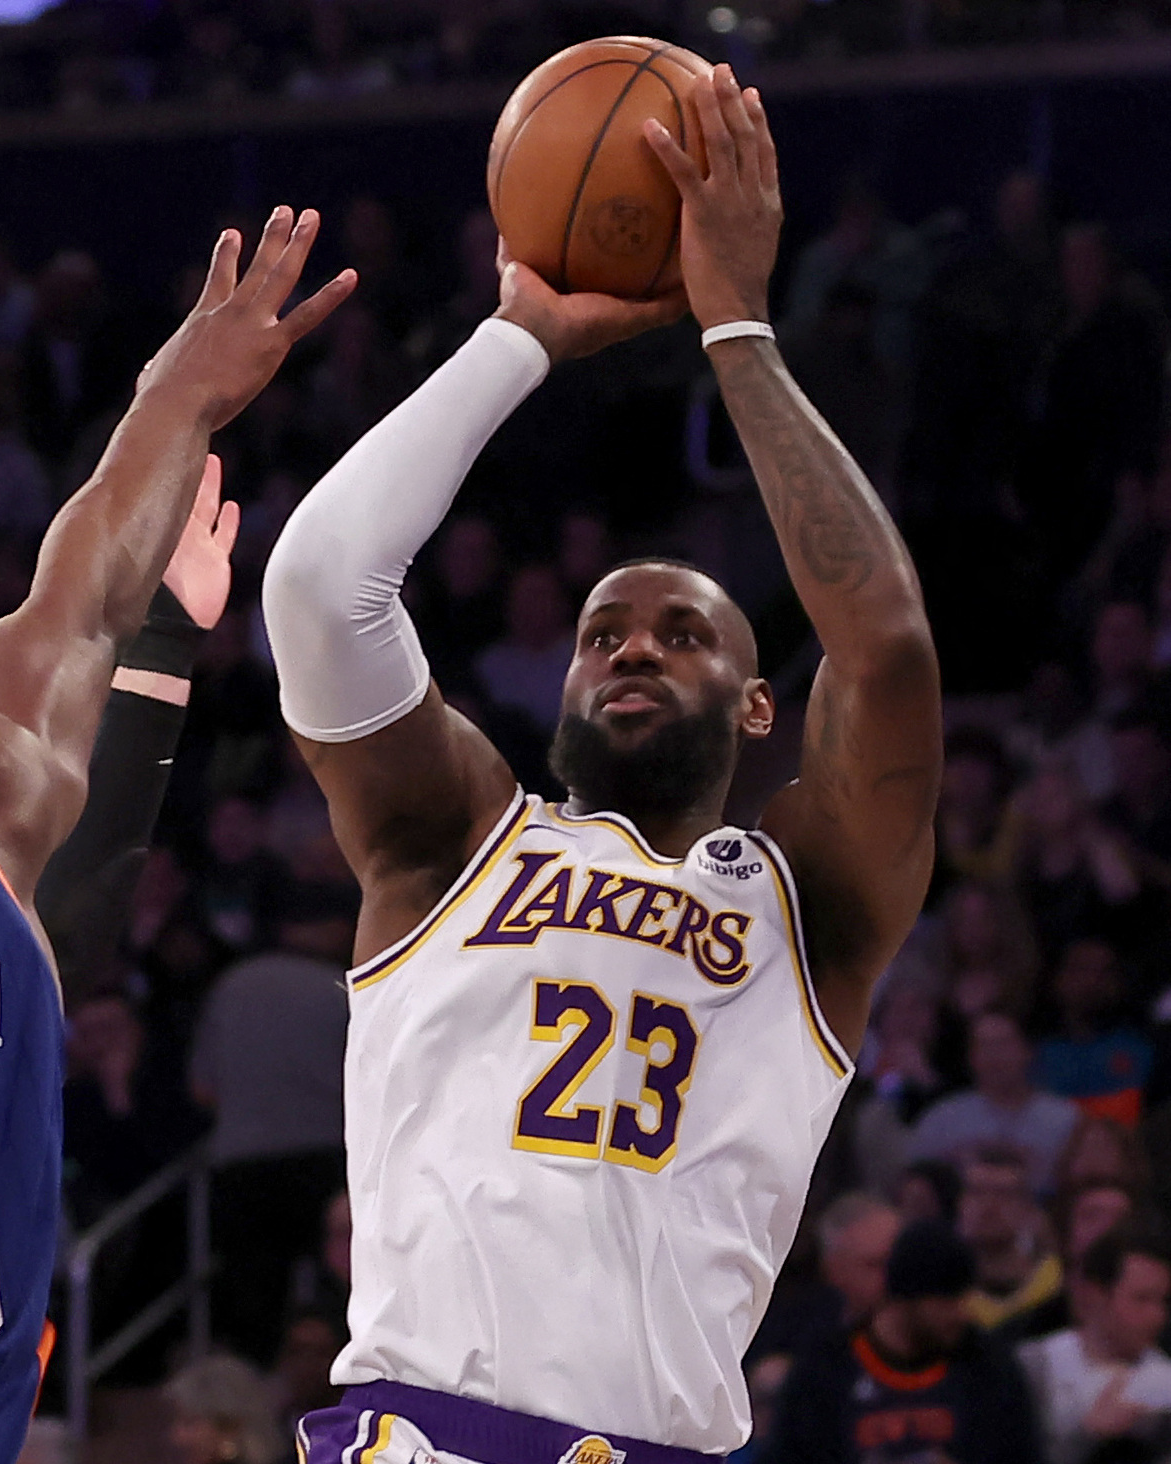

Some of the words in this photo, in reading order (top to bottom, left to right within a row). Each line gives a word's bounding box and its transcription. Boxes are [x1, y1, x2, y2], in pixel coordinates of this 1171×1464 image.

[460, 850, 754, 987] LAKERS
[697, 854, 763, 880] bibigo
[511, 977, 702, 1174] 23
